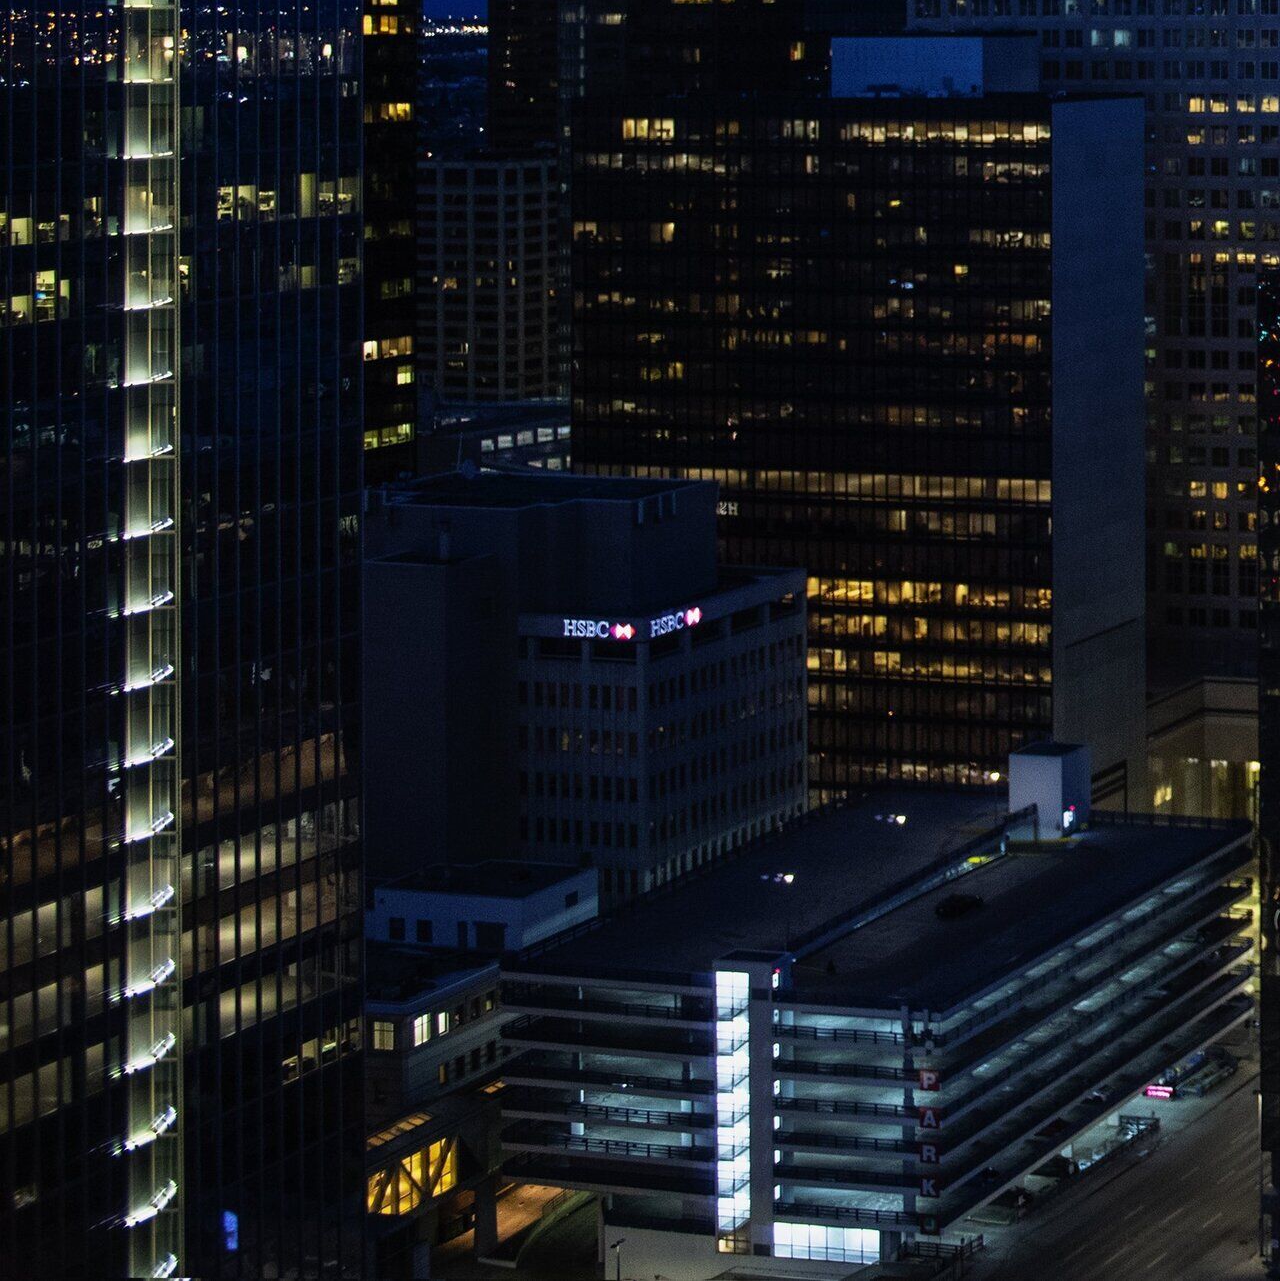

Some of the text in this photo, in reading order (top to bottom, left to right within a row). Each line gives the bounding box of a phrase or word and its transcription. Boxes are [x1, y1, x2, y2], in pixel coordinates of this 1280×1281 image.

[563, 619, 609, 638] HSBC
[650, 611, 685, 637] HSBC
[922, 1072, 937, 1197] PARK
